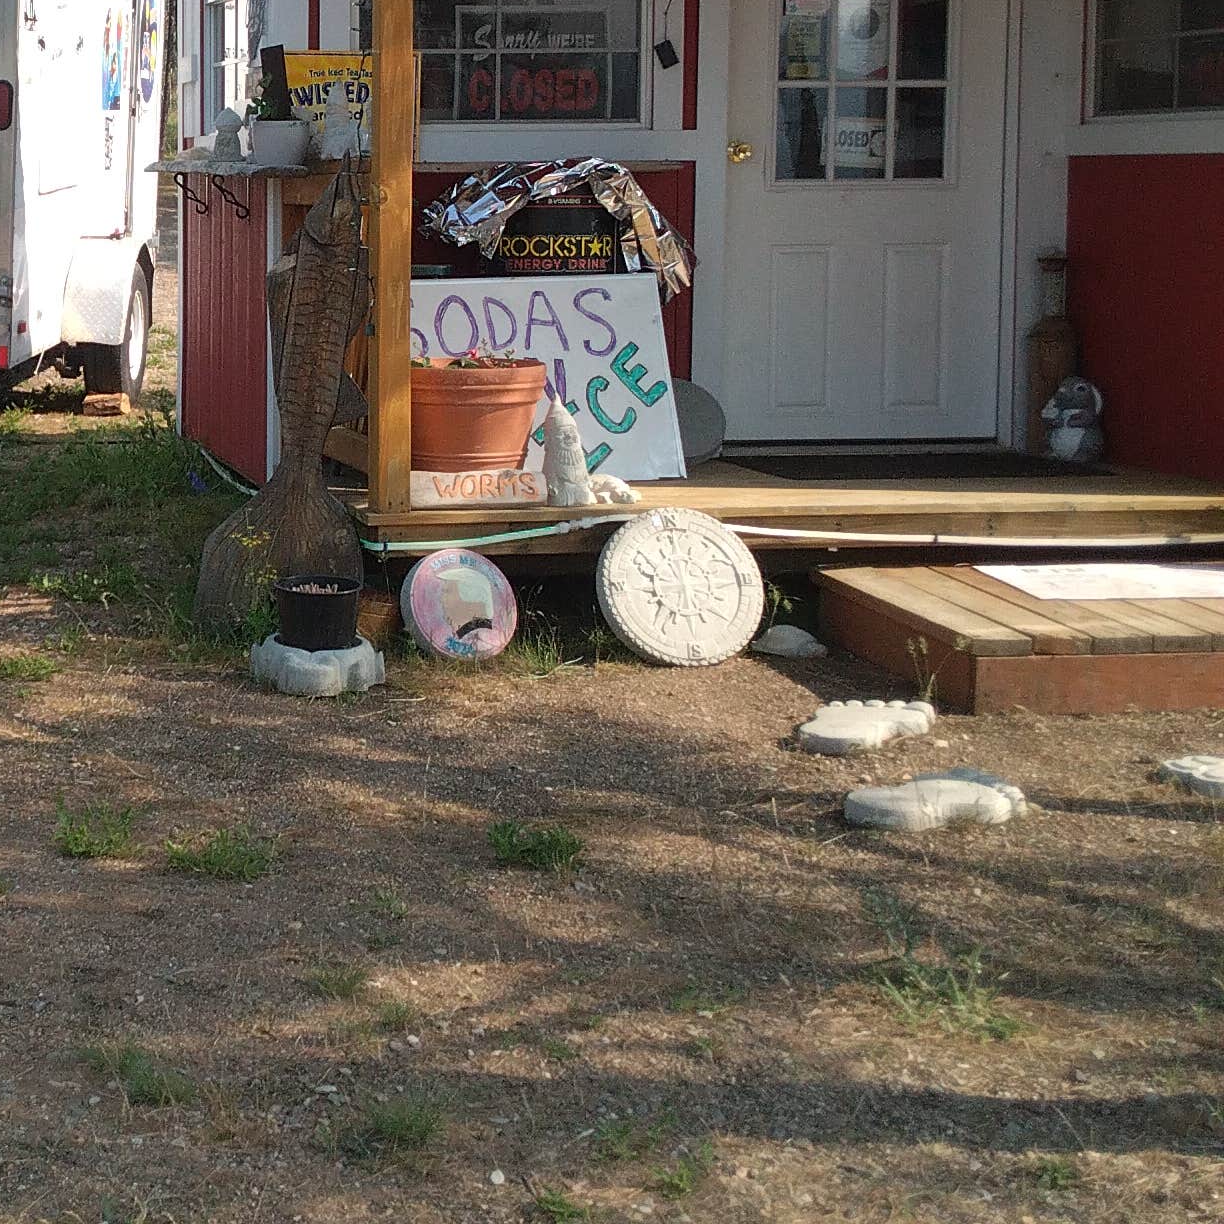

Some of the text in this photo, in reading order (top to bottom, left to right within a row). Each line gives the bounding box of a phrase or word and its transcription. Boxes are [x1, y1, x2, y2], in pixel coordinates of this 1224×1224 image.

[309, 69, 325, 78] True
[362, 69, 373, 78] Tas
[288, 81, 370, 107] WISED
[832, 130, 869, 148] OSED
[507, 257, 607, 270] ENERGY DRINK
[433, 473, 540, 501] WORMS
